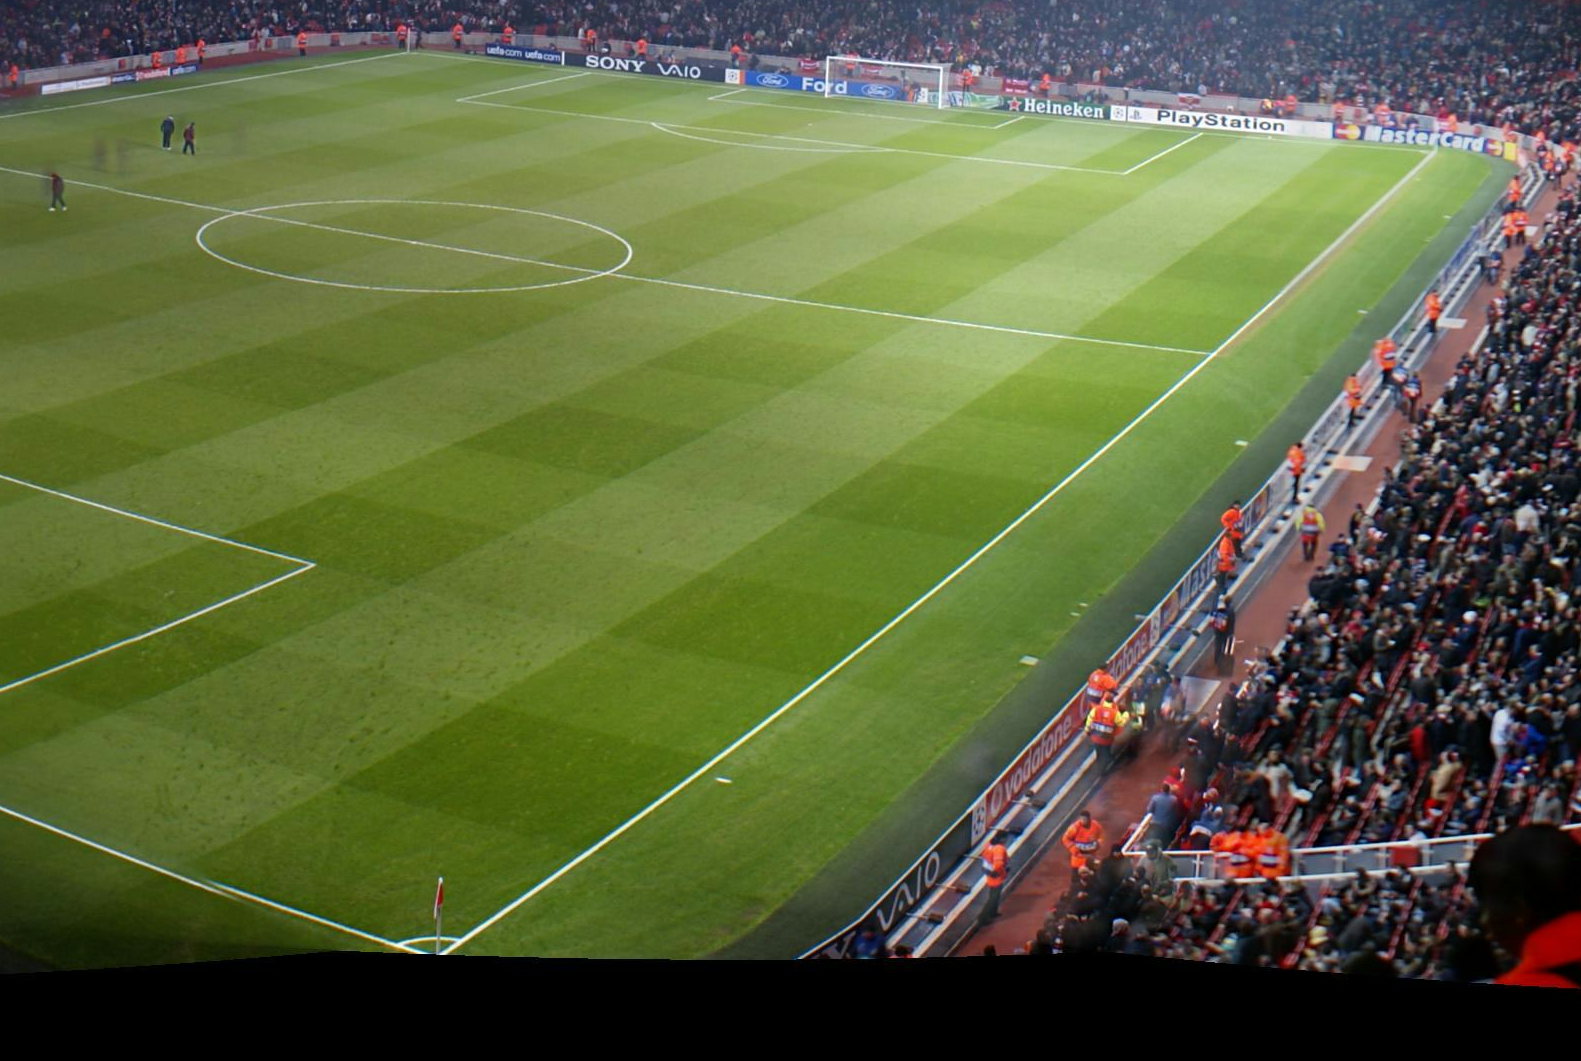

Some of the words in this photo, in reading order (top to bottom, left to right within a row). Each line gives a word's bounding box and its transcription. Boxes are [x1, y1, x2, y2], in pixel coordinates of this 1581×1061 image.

[586, 54, 646, 73] SONY
[657, 62, 701, 79] VAIO
[802, 76, 847, 95] Ford
[1024, 97, 1104, 119] Heineken
[1156, 107, 1285, 132] PlayStation
[1364, 123, 1486, 153] MasterCard
[1002, 718, 1073, 795] vodafone
[877, 851, 940, 931] VAIO
